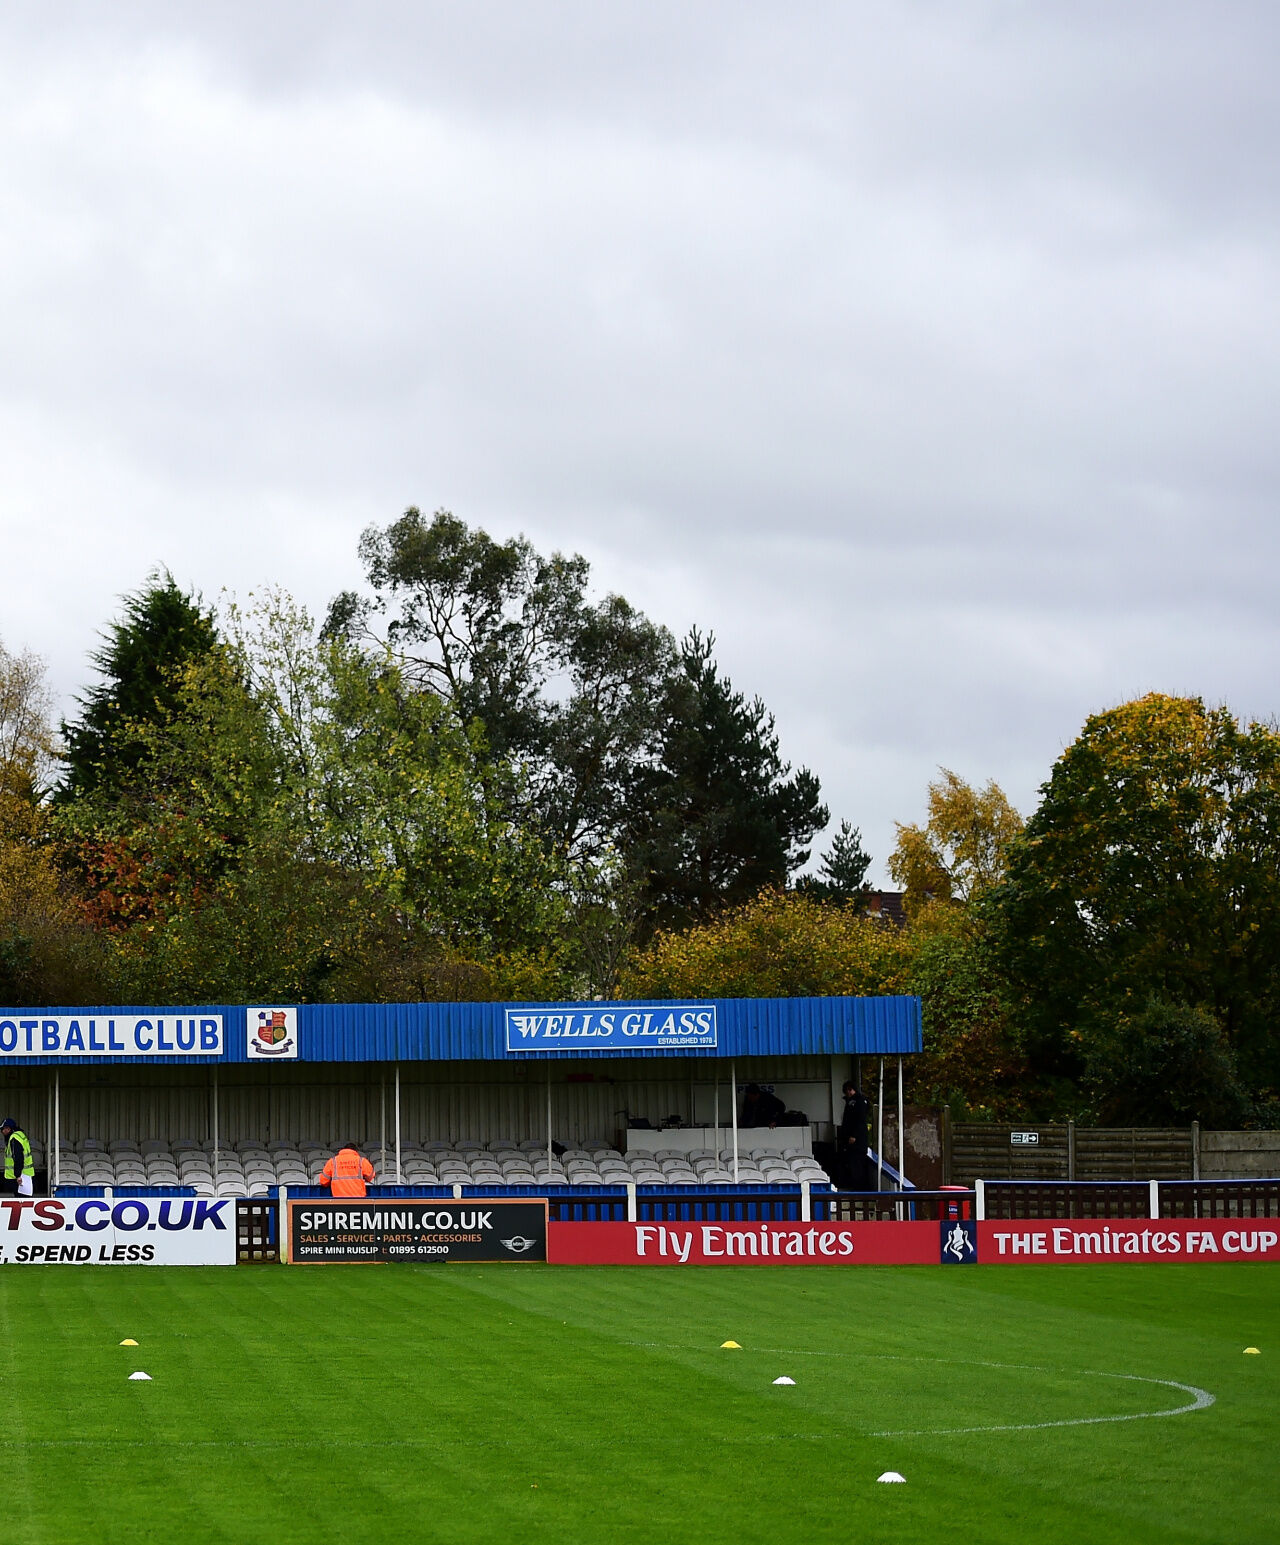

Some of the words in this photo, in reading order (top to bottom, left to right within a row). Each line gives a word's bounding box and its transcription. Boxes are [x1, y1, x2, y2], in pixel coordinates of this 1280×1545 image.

[511, 1013, 616, 1038] WELLS
[621, 1012, 712, 1036] GLASS
[134, 1019, 219, 1051] CLUB
[658, 1037, 698, 1045] ESTABLISHED
[300, 1211, 493, 1230] SPIREMINI.CO.UK
[300, 1234, 329, 1243] SALES
[336, 1234, 375, 1243] SERVICE
[383, 1234, 412, 1243] PARTS
[420, 1233, 482, 1243] ACCESSORIES
[634, 1226, 693, 1263] Fly
[701, 1224, 854, 1256] Emirates
[993, 1233, 1048, 1254] THE
[1051, 1226, 1181, 1254] Emirates
[1186, 1231, 1219, 1253] FA
[1222, 1230, 1278, 1253] CUP
[15, 1245, 92, 1262] SPEND
[99, 1244, 155, 1261] LESS
[300, 1246, 324, 1254] SPIRE
[325, 1246, 345, 1254] MINI
[347, 1246, 379, 1254] RUISLIP
[389, 1246, 416, 1254] 01895
[417, 1246, 449, 1254] 612500
